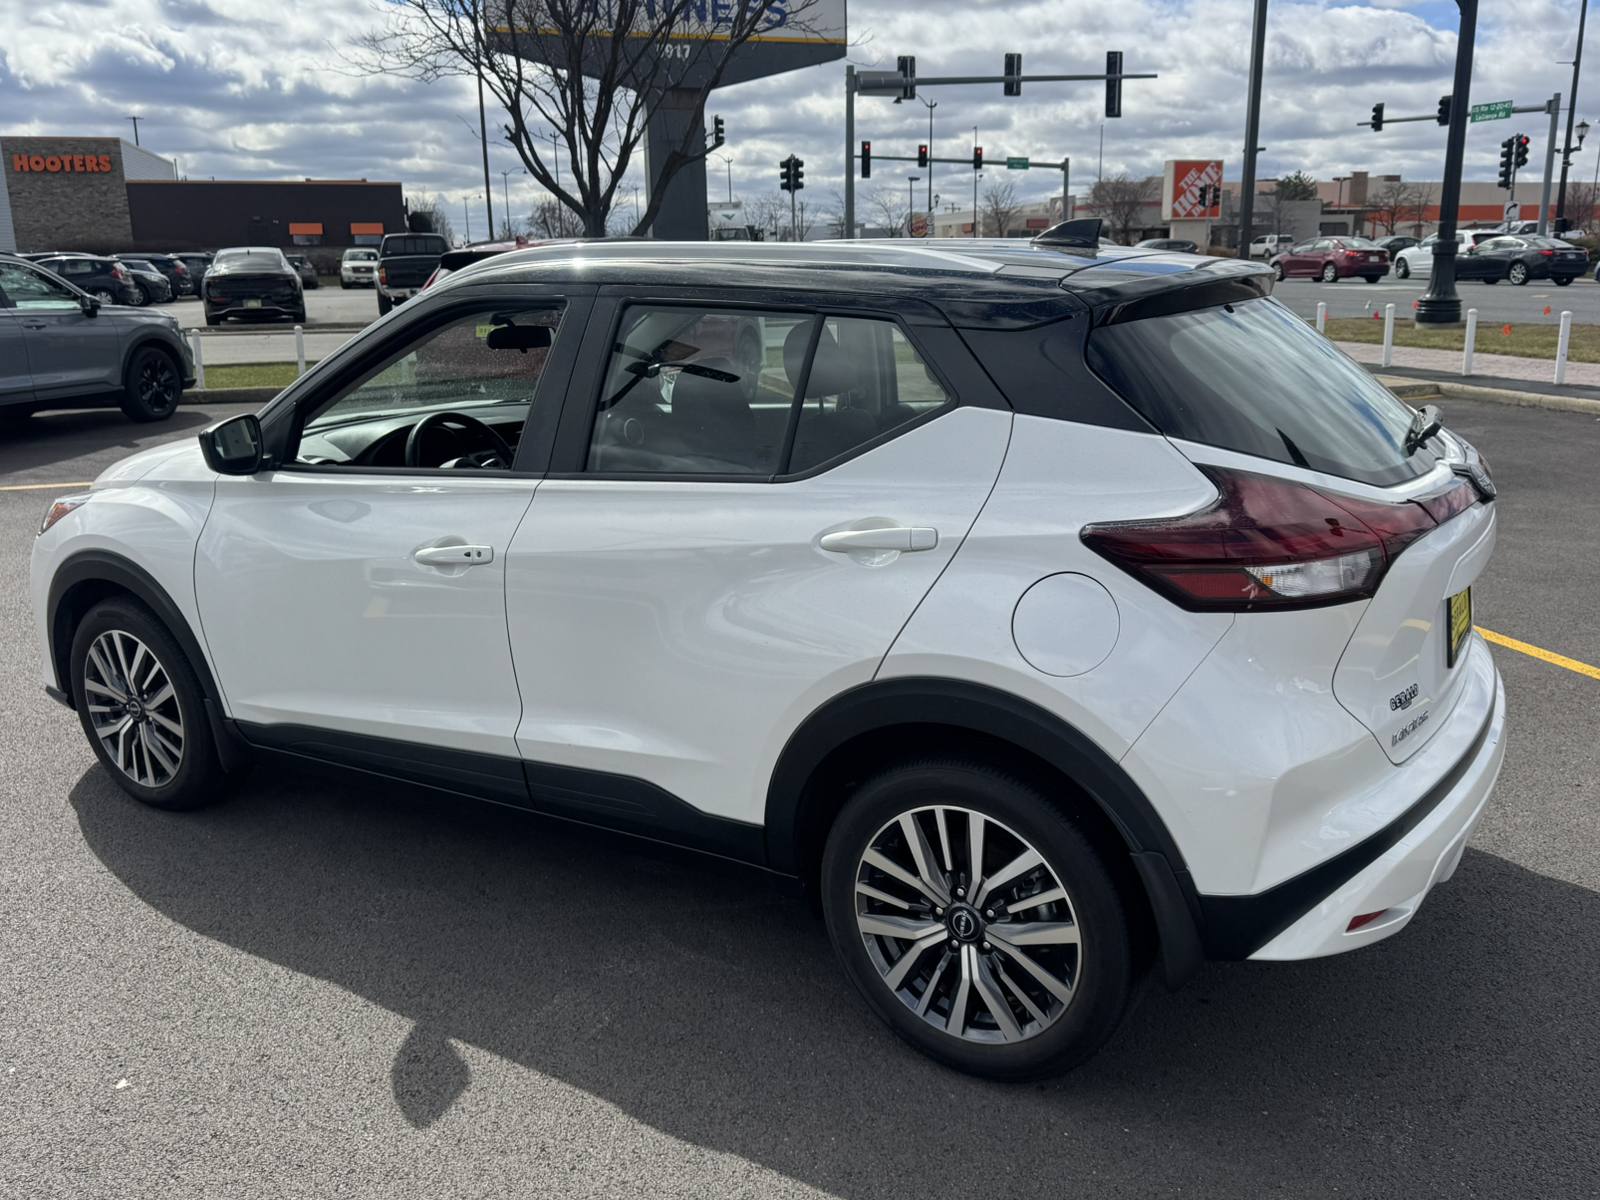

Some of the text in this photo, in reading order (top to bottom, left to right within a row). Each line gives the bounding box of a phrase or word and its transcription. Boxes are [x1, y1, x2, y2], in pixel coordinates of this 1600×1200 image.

[13, 154, 112, 173] HOOTERS
[1178, 167, 1200, 190] THE
[1390, 683, 1419, 711] GERALD
